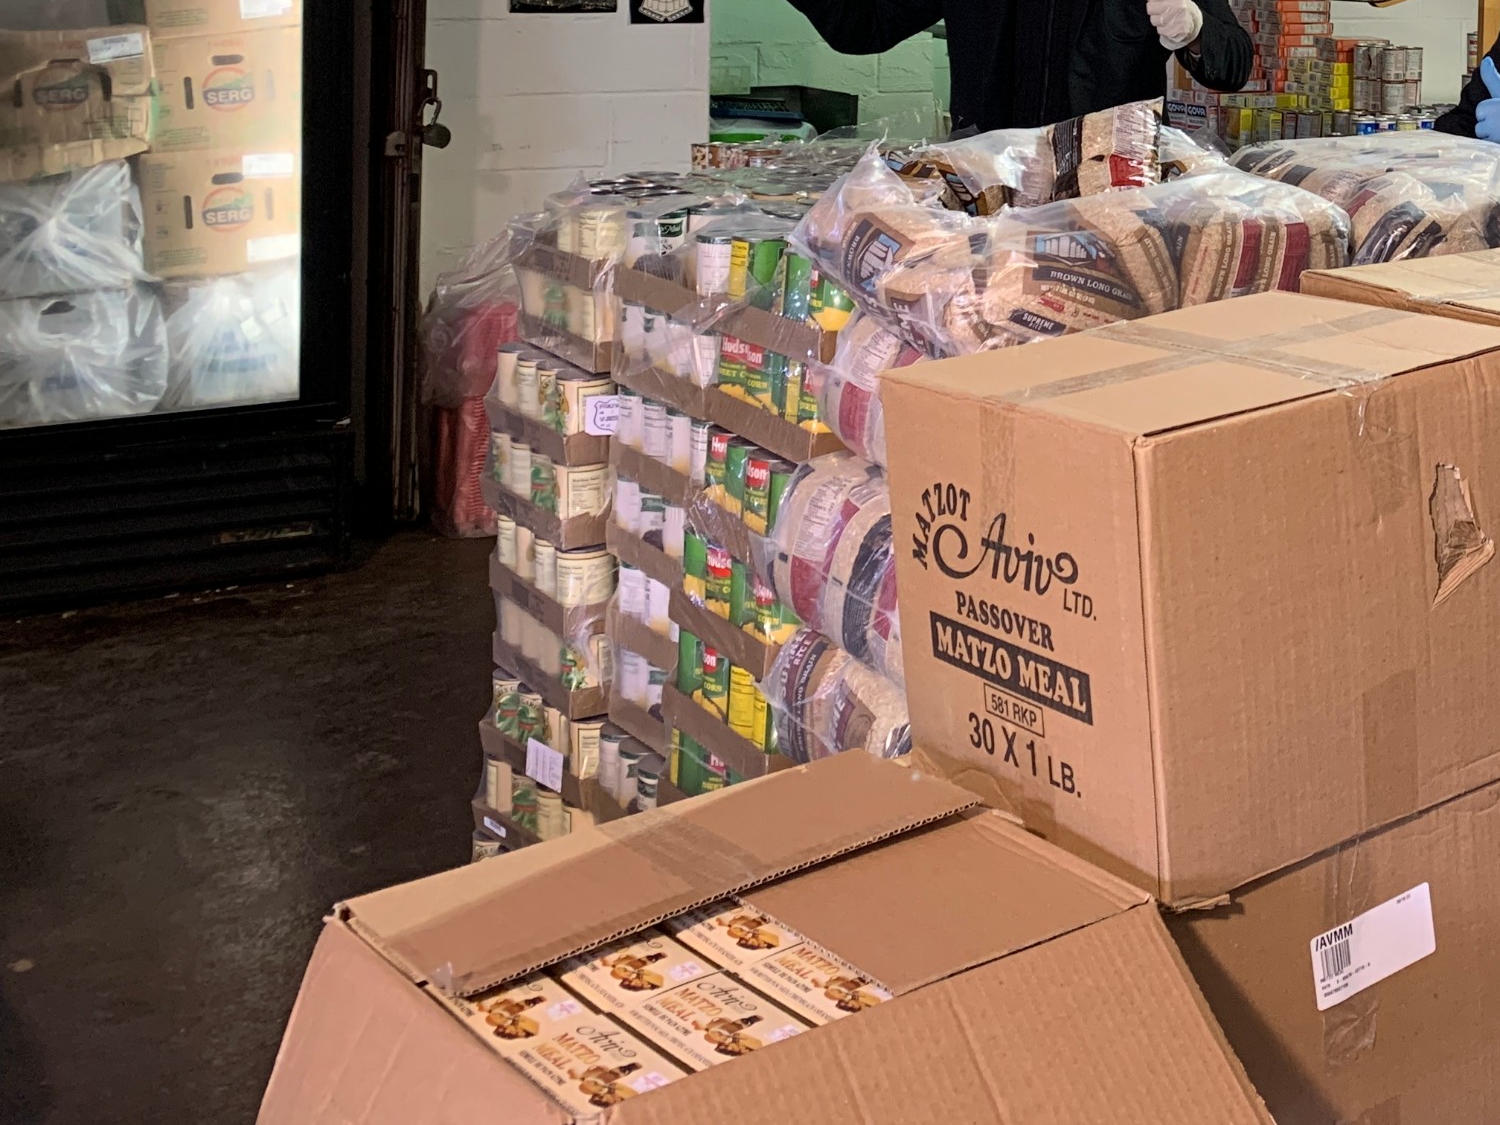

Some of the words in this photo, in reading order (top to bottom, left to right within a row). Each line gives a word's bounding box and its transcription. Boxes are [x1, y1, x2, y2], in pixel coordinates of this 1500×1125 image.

[36, 87, 87, 103] SERG
[206, 88, 253, 104] SERG
[1168, 103, 1185, 113] GOYA
[1188, 106, 1206, 116] GOYA
[1050, 270, 1085, 285] BROWN
[1087, 279, 1111, 293] LONG
[1112, 287, 1133, 300] GRAIN
[1213, 271, 1226, 298] BROWN
[1222, 246, 1231, 269] LONG
[1022, 312, 1054, 330] SUPREME
[722, 336, 745, 354] Huds
[913, 482, 971, 570] MATZOT
[932, 512, 1079, 595] Aviv
[1063, 588, 1097, 621] LTD.
[955, 590, 1054, 652] PASSOVER
[935, 622, 1012, 681] MATZO
[1017, 654, 1087, 714] MEAL
[991, 693, 1009, 717] 581
[1013, 705, 1037, 728] RKP
[968, 712, 995, 756] 30
[1002, 727, 1019, 768] X
[1027, 740, 1037, 777] 1
[1048, 755, 1082, 799] LB.
[656, 996, 689, 1022] MEAL
[674, 987, 723, 1018] MATZO
[533, 1043, 570, 1072] MEAL
[552, 1033, 600, 1065] MATZO
